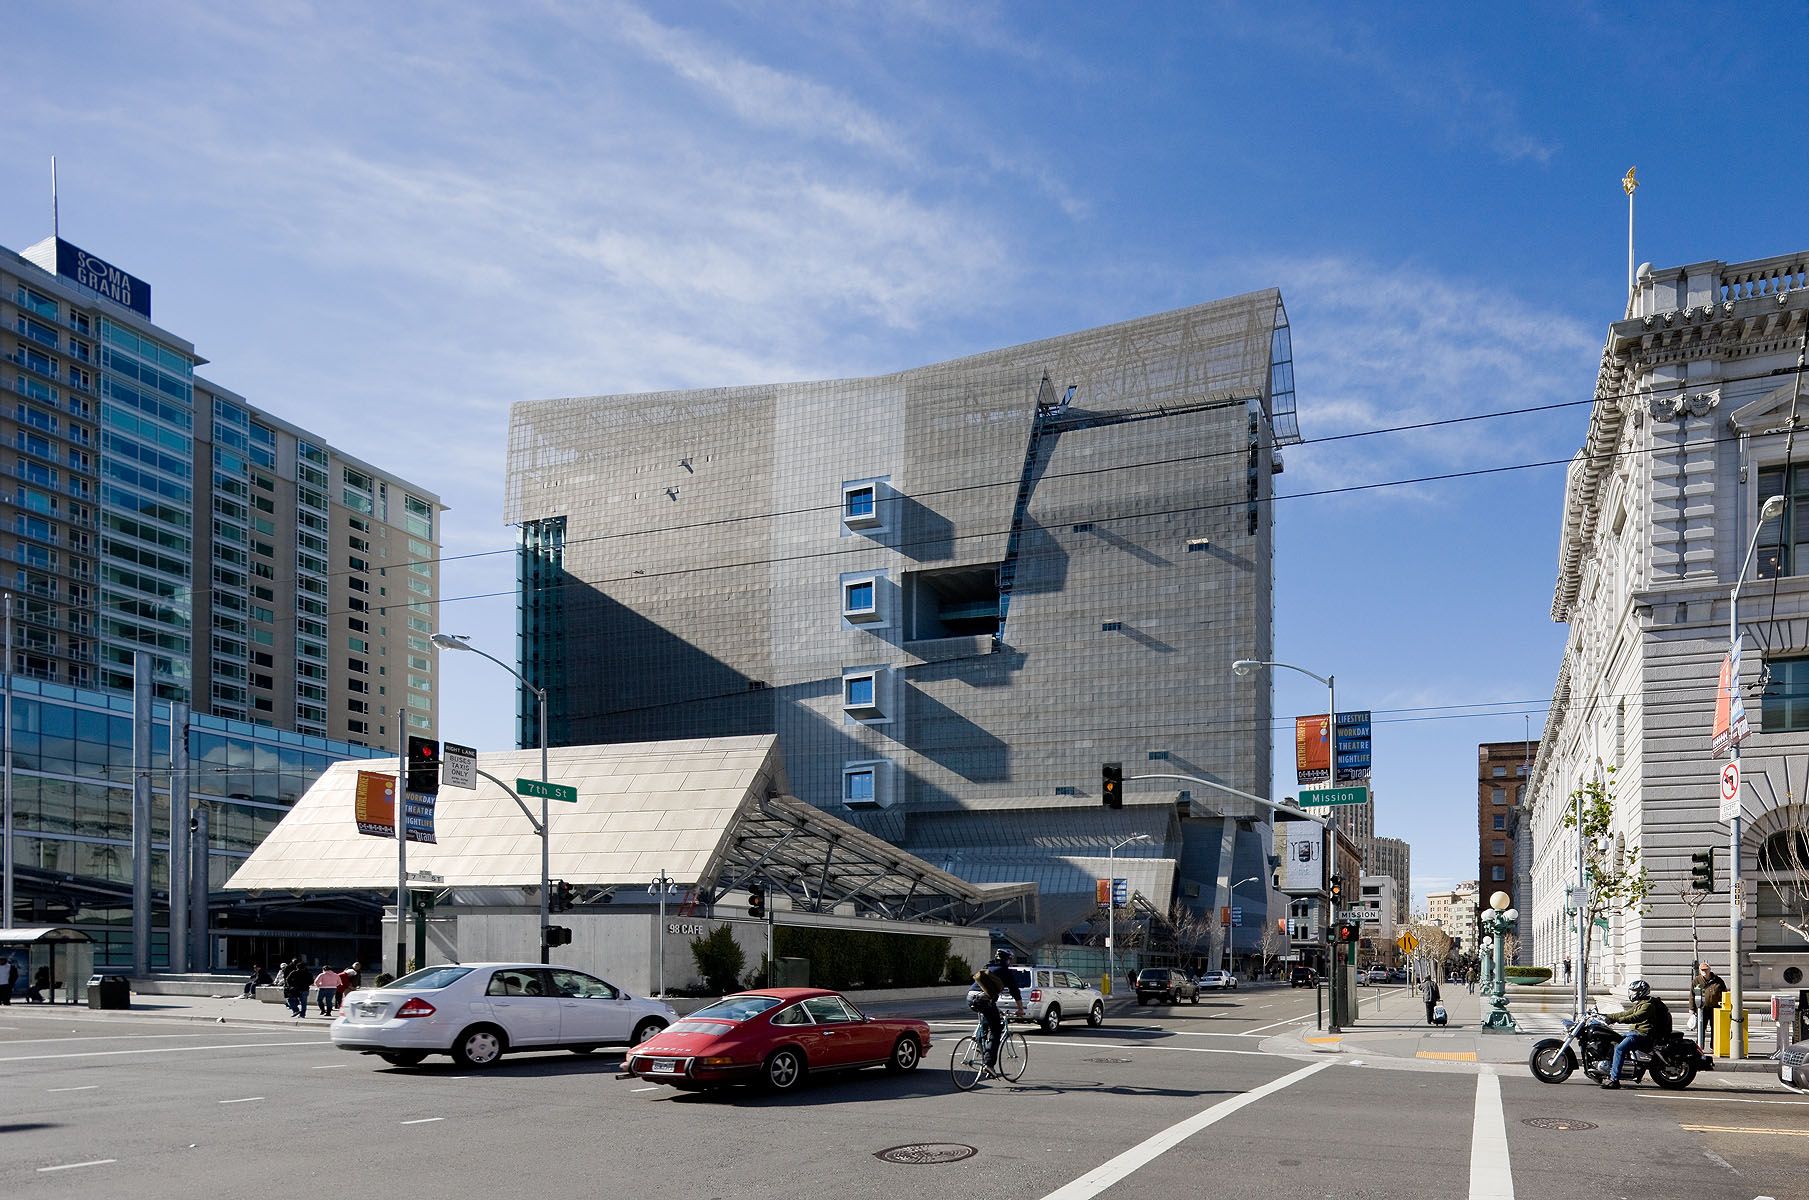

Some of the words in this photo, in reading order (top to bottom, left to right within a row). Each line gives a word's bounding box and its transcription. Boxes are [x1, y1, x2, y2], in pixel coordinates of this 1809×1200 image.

[77, 251, 130, 290] SOMA
[77, 267, 131, 305] GRAND
[1338, 713, 1369, 723] LIFESTYLE
[1337, 727, 1370, 737] WORKDAY
[445, 745, 461, 753] RIGHT
[1338, 741, 1369, 750] THEATRE
[449, 755, 471, 765] BUSES
[1297, 742, 1306, 768] CENTRAL
[1337, 754, 1370, 764] NIGHTLIFE
[452, 762, 470, 771] TAXIS
[451, 768, 468, 777] ONLY
[527, 783, 548, 795] 7th
[554, 788, 567, 798] St
[1312, 793, 1354, 803] Mission
[669, 924, 680, 934] 98
[681, 925, 704, 935] CAFE
